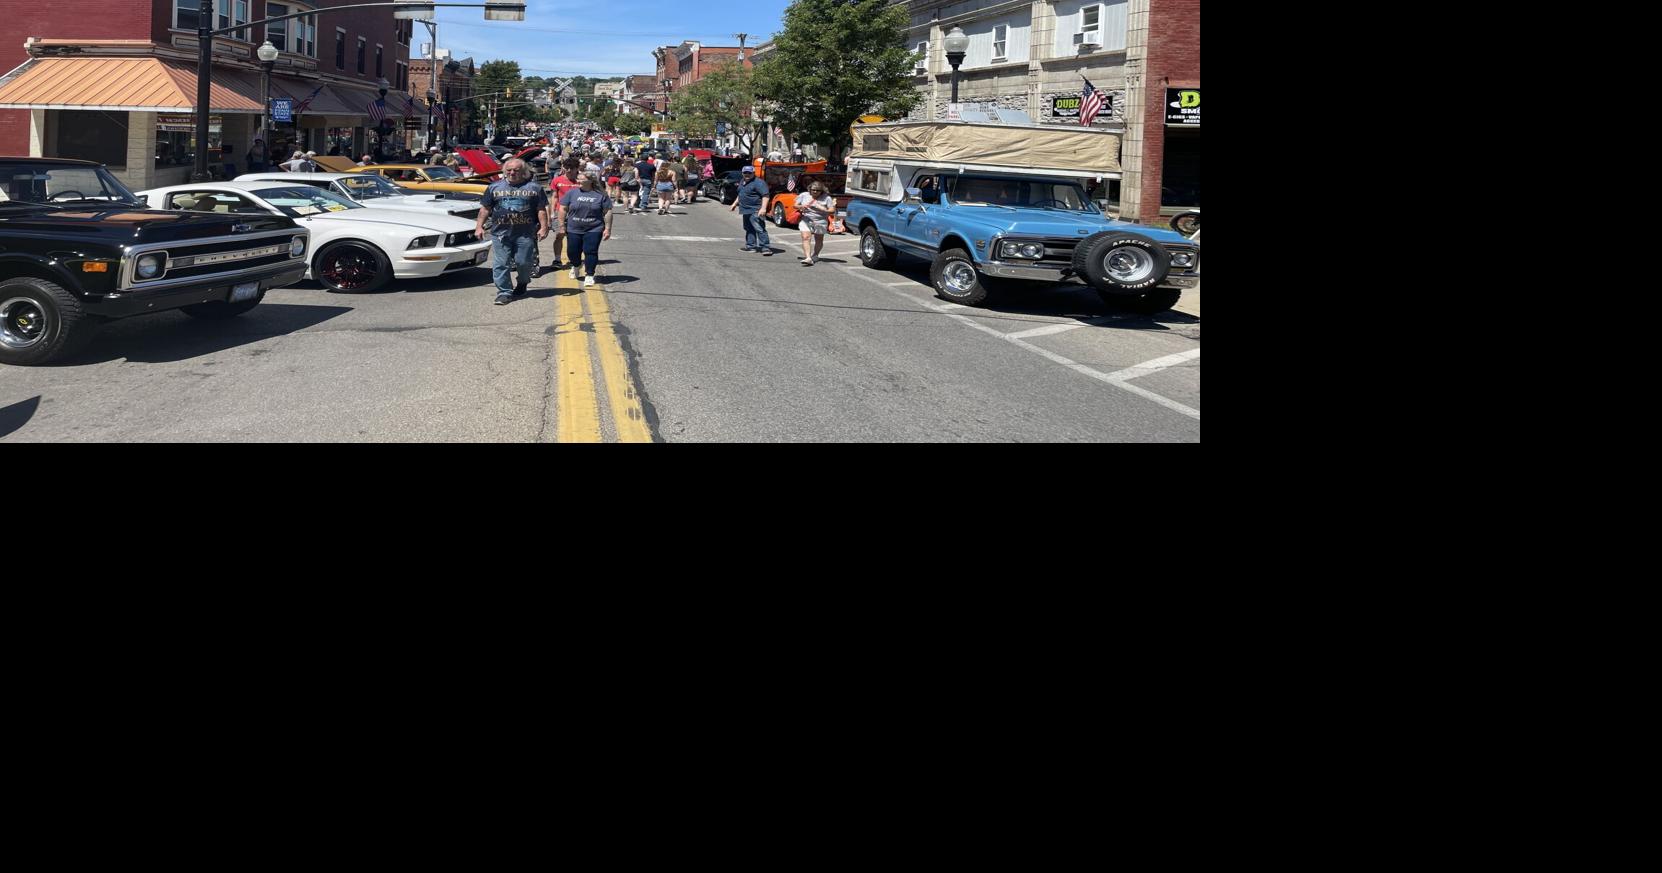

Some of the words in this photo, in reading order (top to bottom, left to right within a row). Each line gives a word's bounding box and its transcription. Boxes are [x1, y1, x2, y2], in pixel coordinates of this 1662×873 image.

[1056, 98, 1080, 109] DUBZ
[505, 190, 521, 198] NOT
[1121, 278, 1156, 289] RADIAL
